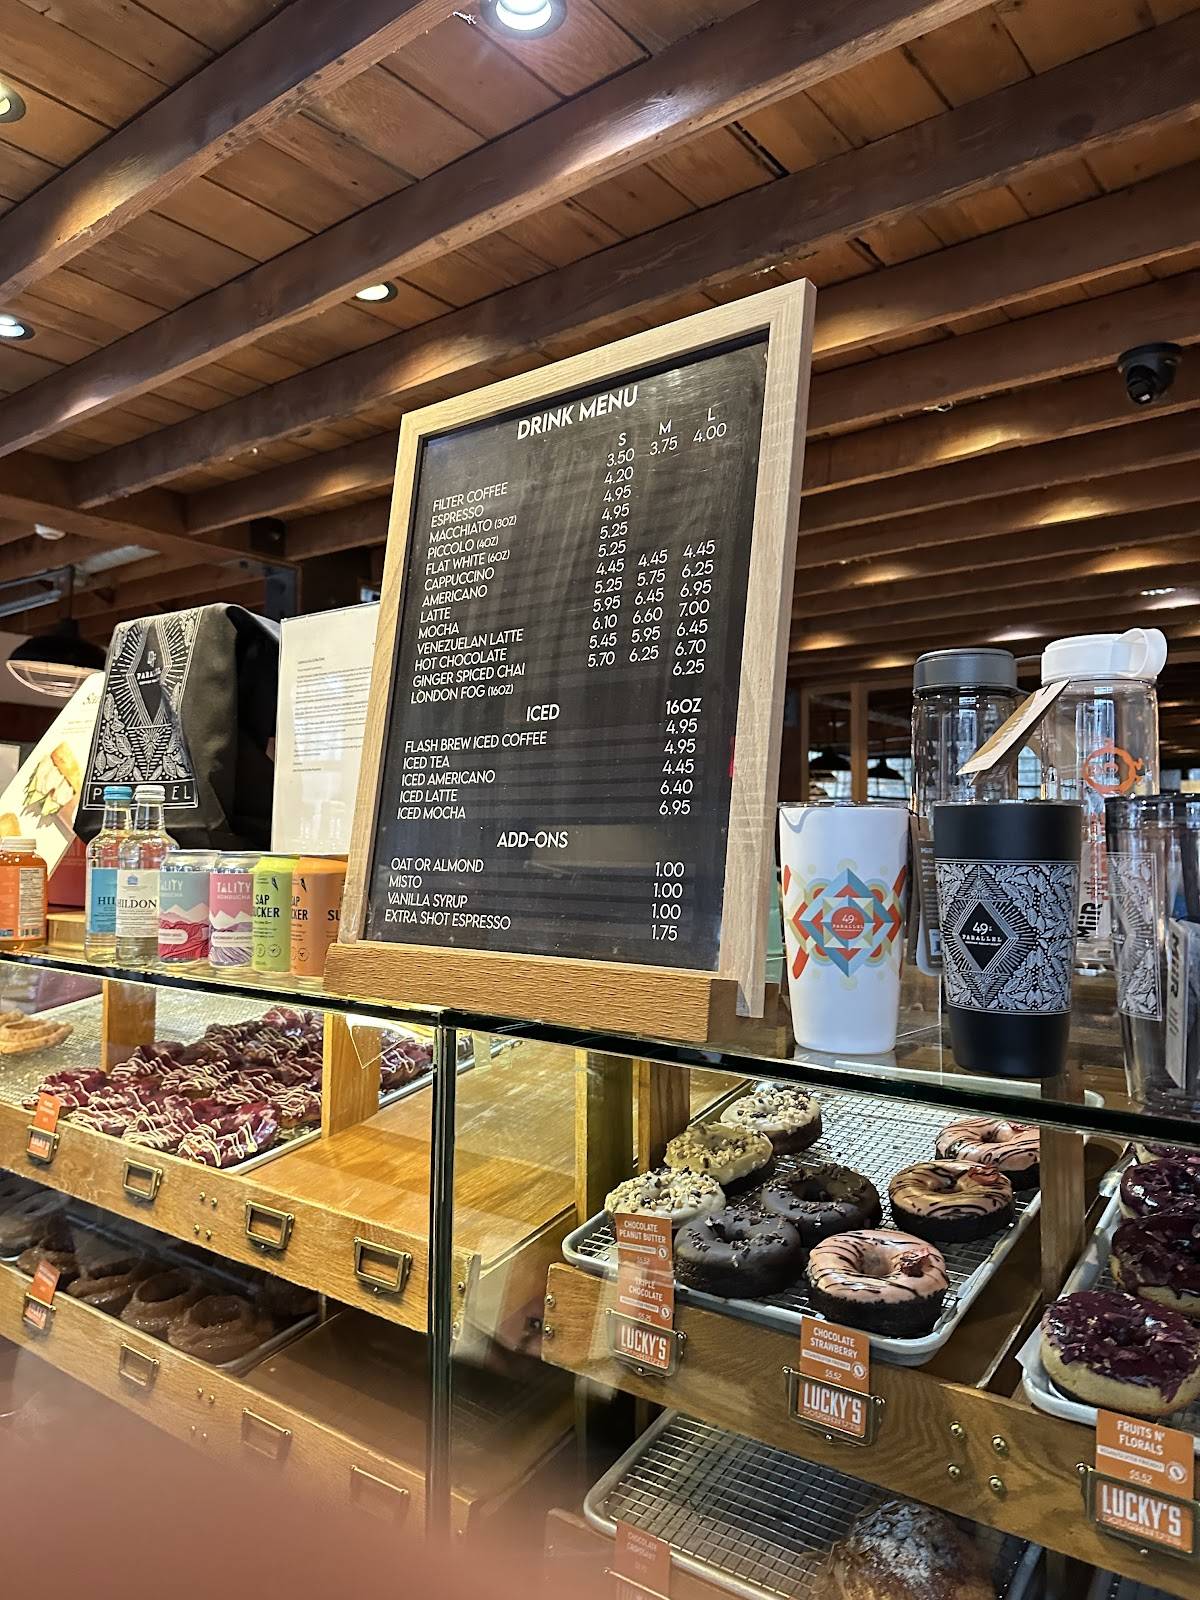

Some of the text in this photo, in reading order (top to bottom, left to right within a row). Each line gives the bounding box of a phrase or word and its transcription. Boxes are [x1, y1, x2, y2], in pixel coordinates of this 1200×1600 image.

[517, 385, 638, 440] DRINK MENU
[618, 407, 716, 446] S M L
[432, 422, 727, 512] FILTER COFFEE 3.50 3.75 4.00
[429, 519, 493, 544] MACCHIATO
[603, 485, 632, 503] 4.95
[431, 466, 634, 528] ESPRESSO 4.20
[425, 559, 451, 576] FLAT
[452, 552, 486, 570] WHITE
[600, 521, 628, 540] 5.25
[427, 539, 475, 560] PICCOLO
[601, 503, 630, 521] 4.95
[422, 540, 715, 608] AMERICANO 4.45 4.45 4.45
[424, 540, 626, 592] CAPPUCCINO 5.25
[418, 579, 712, 640] MOCHA 5.95 6.45 6.95
[420, 560, 714, 624] LATTE 5.25 5.75 6.25
[417, 599, 710, 655] VENEZUELAN LATTE 6.10 6.60 7.00
[414, 619, 708, 672] HOT CHOCOLATE 5.45 5.95 6.45
[412, 639, 706, 688] GINGER SPICED CHAI 5.70 6.25 6.70
[410, 687, 459, 705] LONDON
[460, 684, 486, 700] FOG
[672, 659, 705, 676] 6.25
[526, 703, 560, 722] ICED
[405, 718, 698, 753] FLASH BREW ICED COFFEE 4.95
[403, 738, 696, 770] ICED TEA 4.95
[401, 759, 695, 787] ICED AMERICANO 4.45
[399, 779, 694, 803] ICED LATTE 6.40
[397, 799, 691, 820] ICED MOCHA 6.95
[497, 831, 569, 848] ADD-ONS
[391, 857, 685, 878] OAT OR ALMOND 1.00
[255, 894, 270, 905] SAP
[388, 875, 683, 899] MISTO 1.00
[387, 892, 681, 920] VANILLA SYRUP 1.00
[384, 909, 678, 941] EXTRA SHOT ESPRESSO 1.75
[619, 1228, 667, 1244] PEANUT BUTTER
[624, 1219, 659, 1233] CHOCOLATE
[629, 1284, 663, 1302] CHOCOLATE
[621, 1324, 667, 1361] LUCKY'S
[810, 1337, 858, 1359] STRAWBERRY
[813, 1327, 855, 1347] CHOCOLATE
[803, 1382, 861, 1424] LUCKY'S
[1117, 1420, 1152, 1438] FRUITS
[1119, 1434, 1164, 1456] FLORALS
[1102, 1484, 1182, 1537] LUCKY'S
